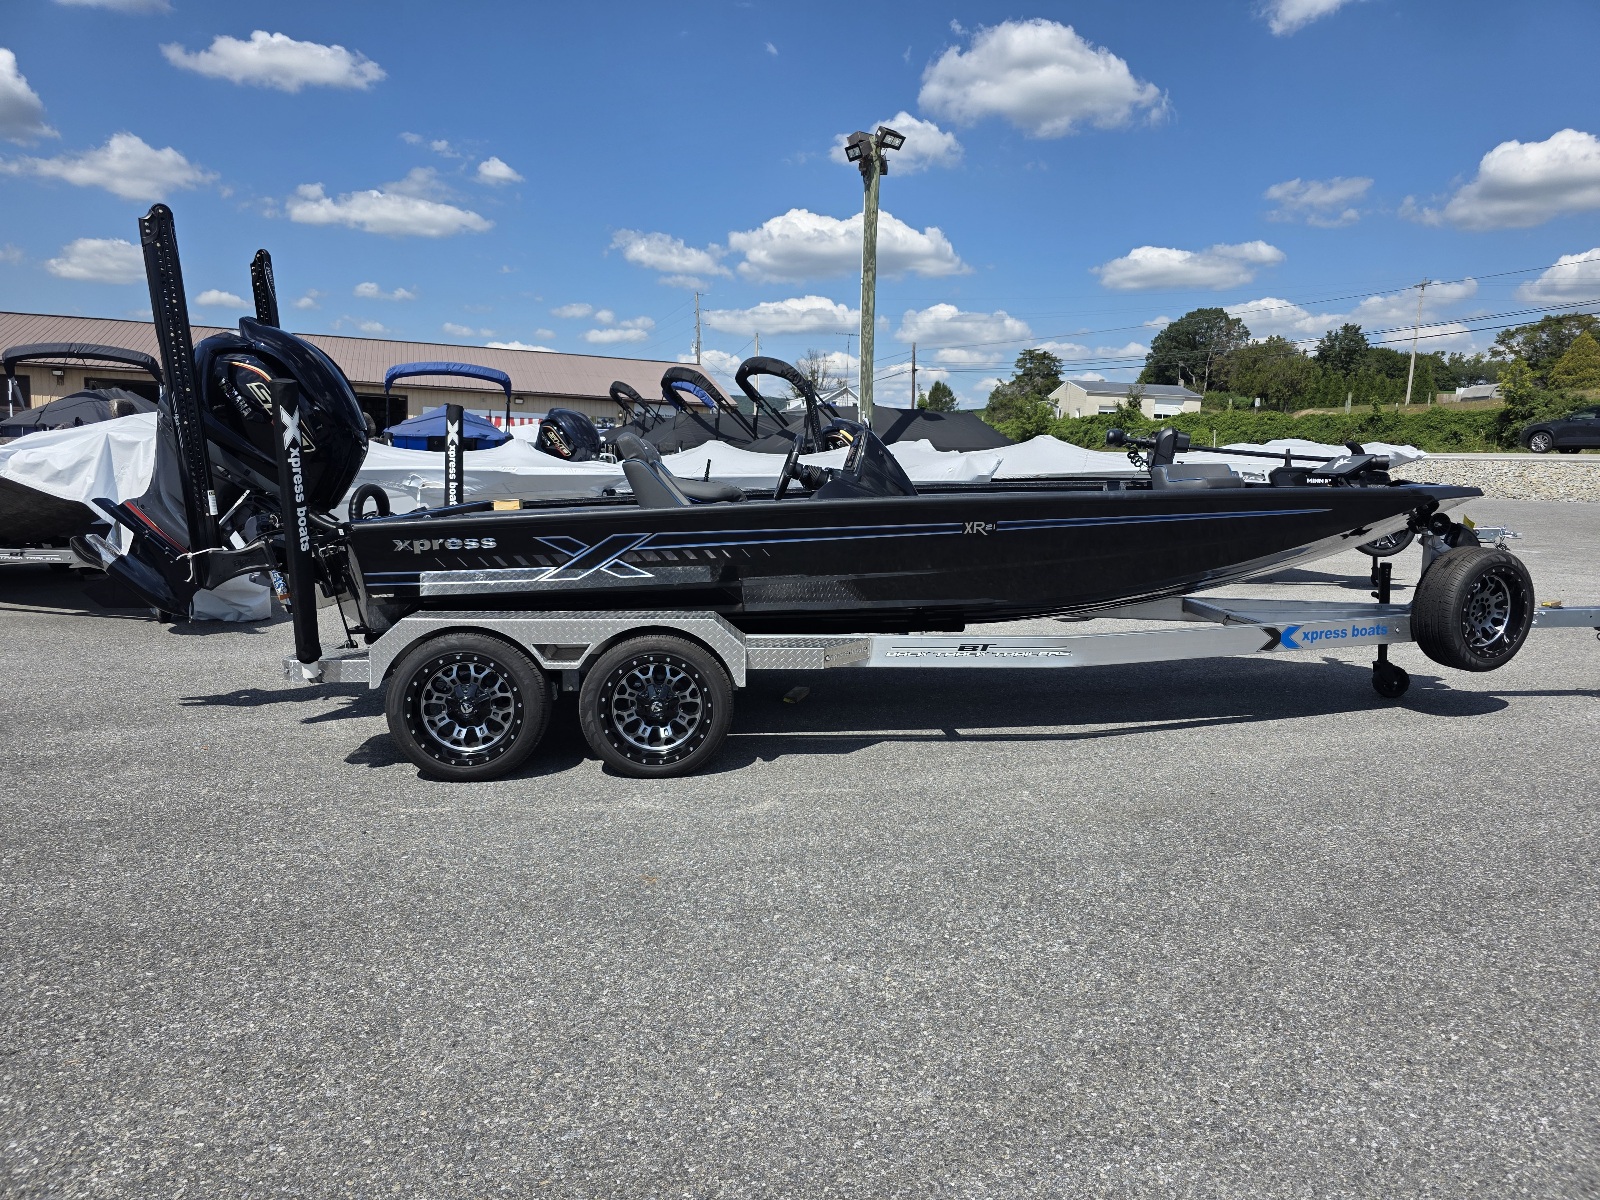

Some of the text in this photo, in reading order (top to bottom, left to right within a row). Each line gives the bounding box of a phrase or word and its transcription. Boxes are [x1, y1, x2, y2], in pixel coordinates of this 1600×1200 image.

[447, 445, 459, 506] xpress boat
[287, 447, 310, 552] xpress boats
[392, 536, 497, 554] xpress
[1302, 624, 1388, 643] xpress boats
[957, 643, 997, 652] BT
